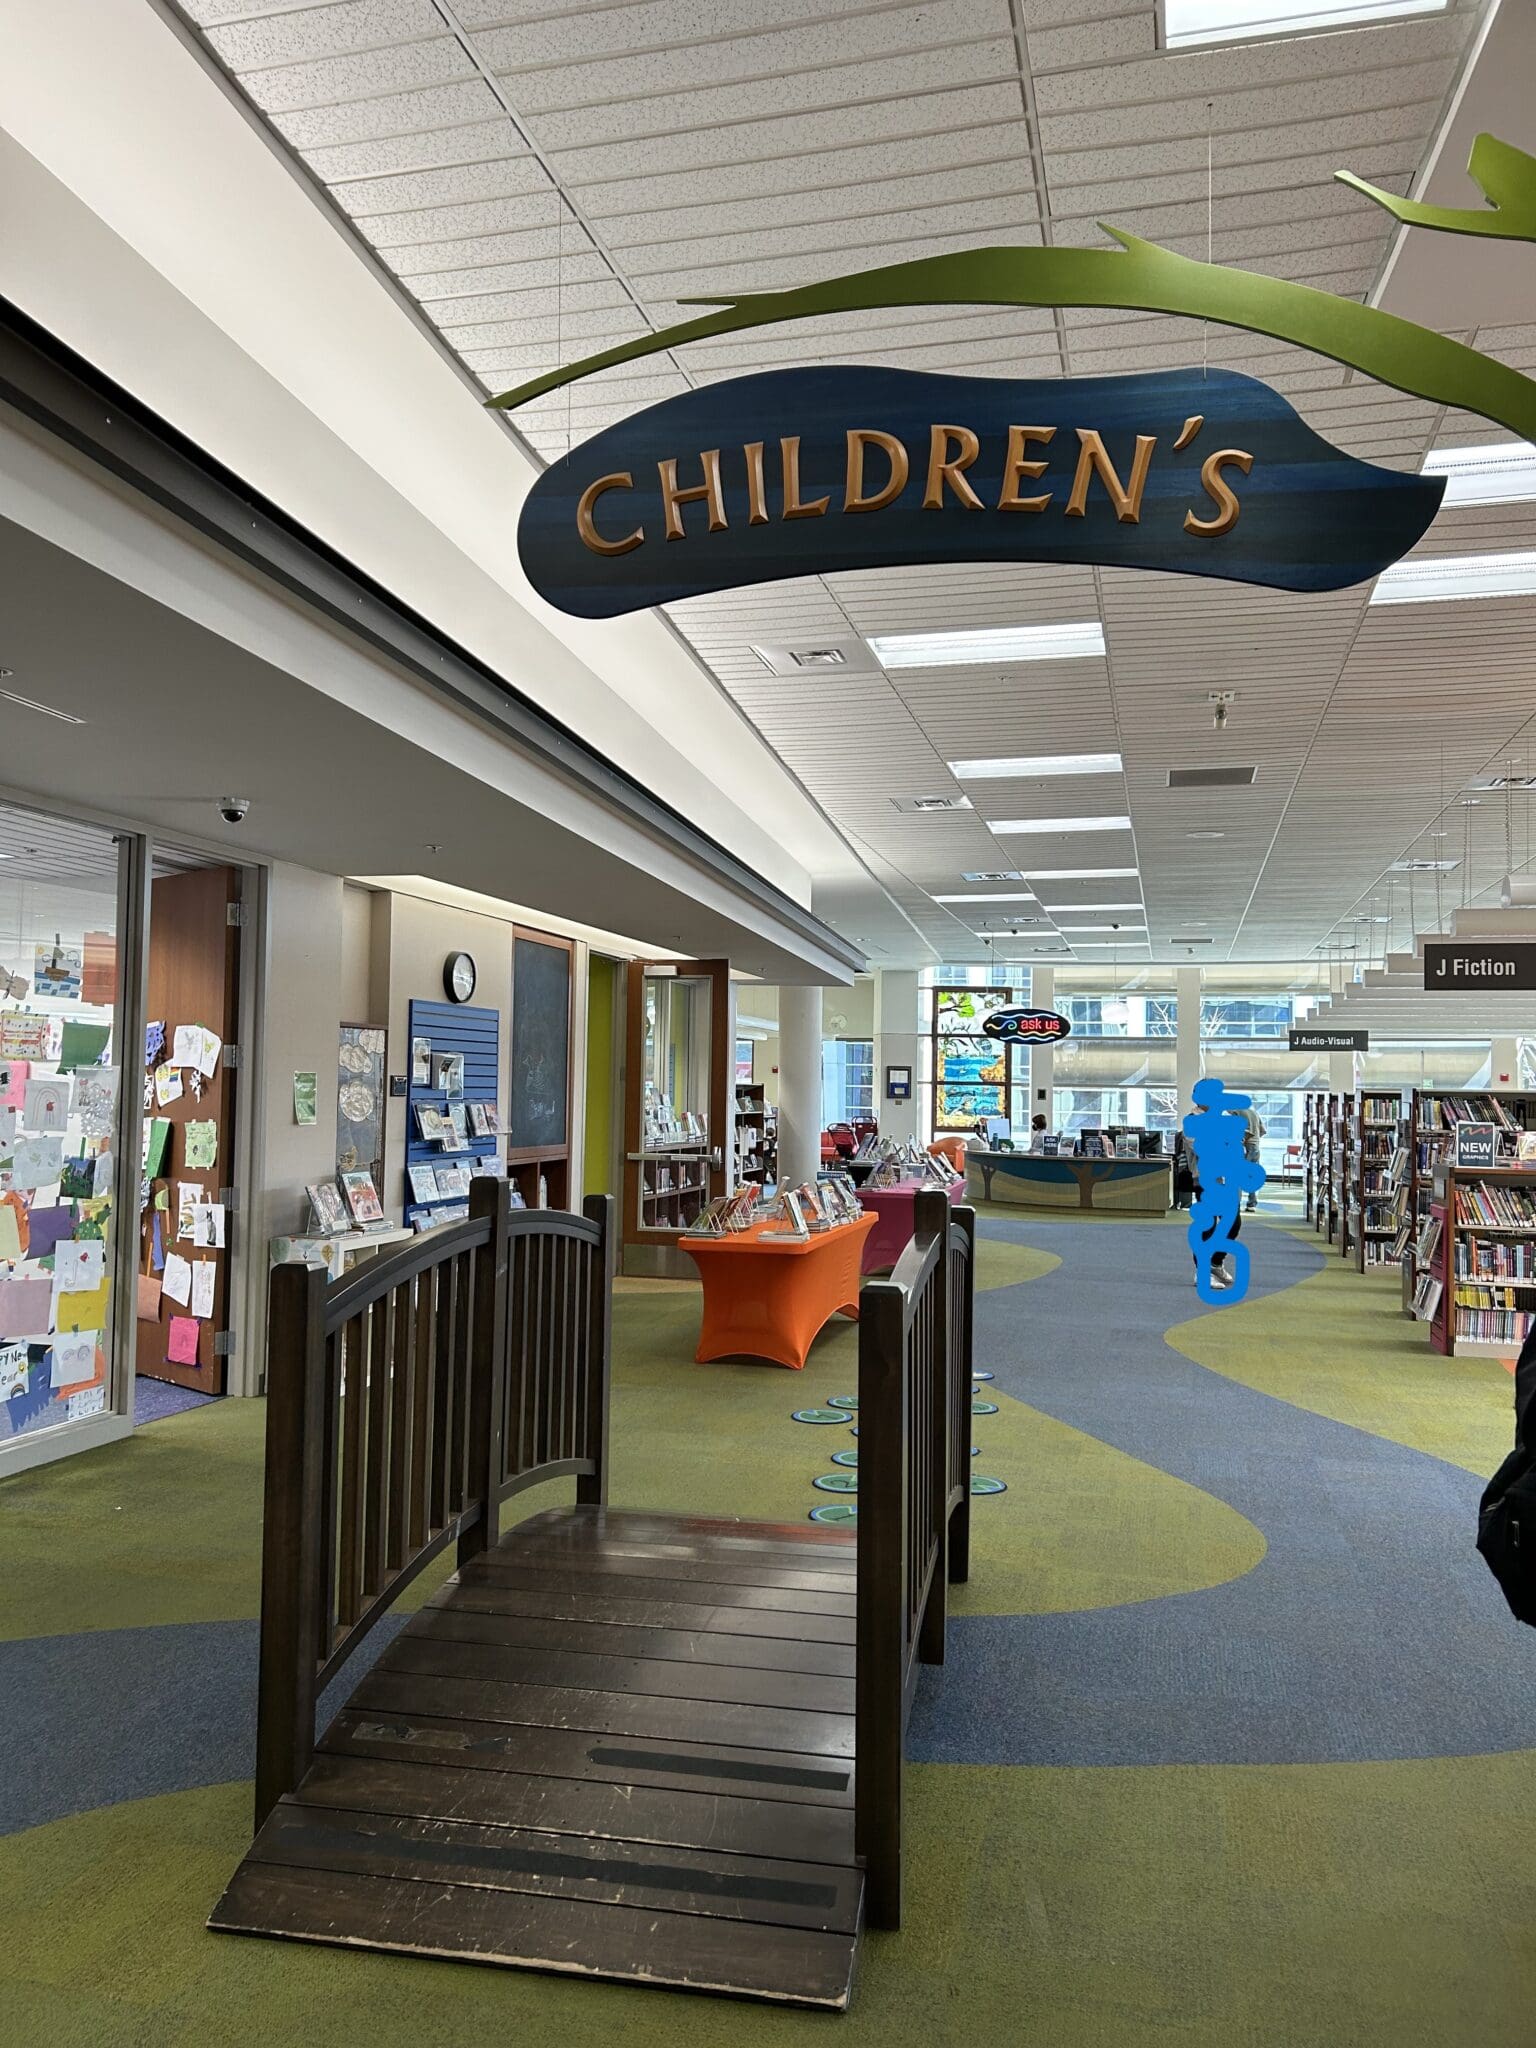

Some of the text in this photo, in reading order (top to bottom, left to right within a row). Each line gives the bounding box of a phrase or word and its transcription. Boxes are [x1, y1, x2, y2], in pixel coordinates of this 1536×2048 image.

[576, 414, 1254, 557] CHILDREN'S
[1436, 958, 1516, 976] J Fiction
[1020, 1018, 1060, 1030] ask us
[1294, 1036, 1354, 1046] J Audio-Visual
[1460, 1142, 1492, 1153] NEW
